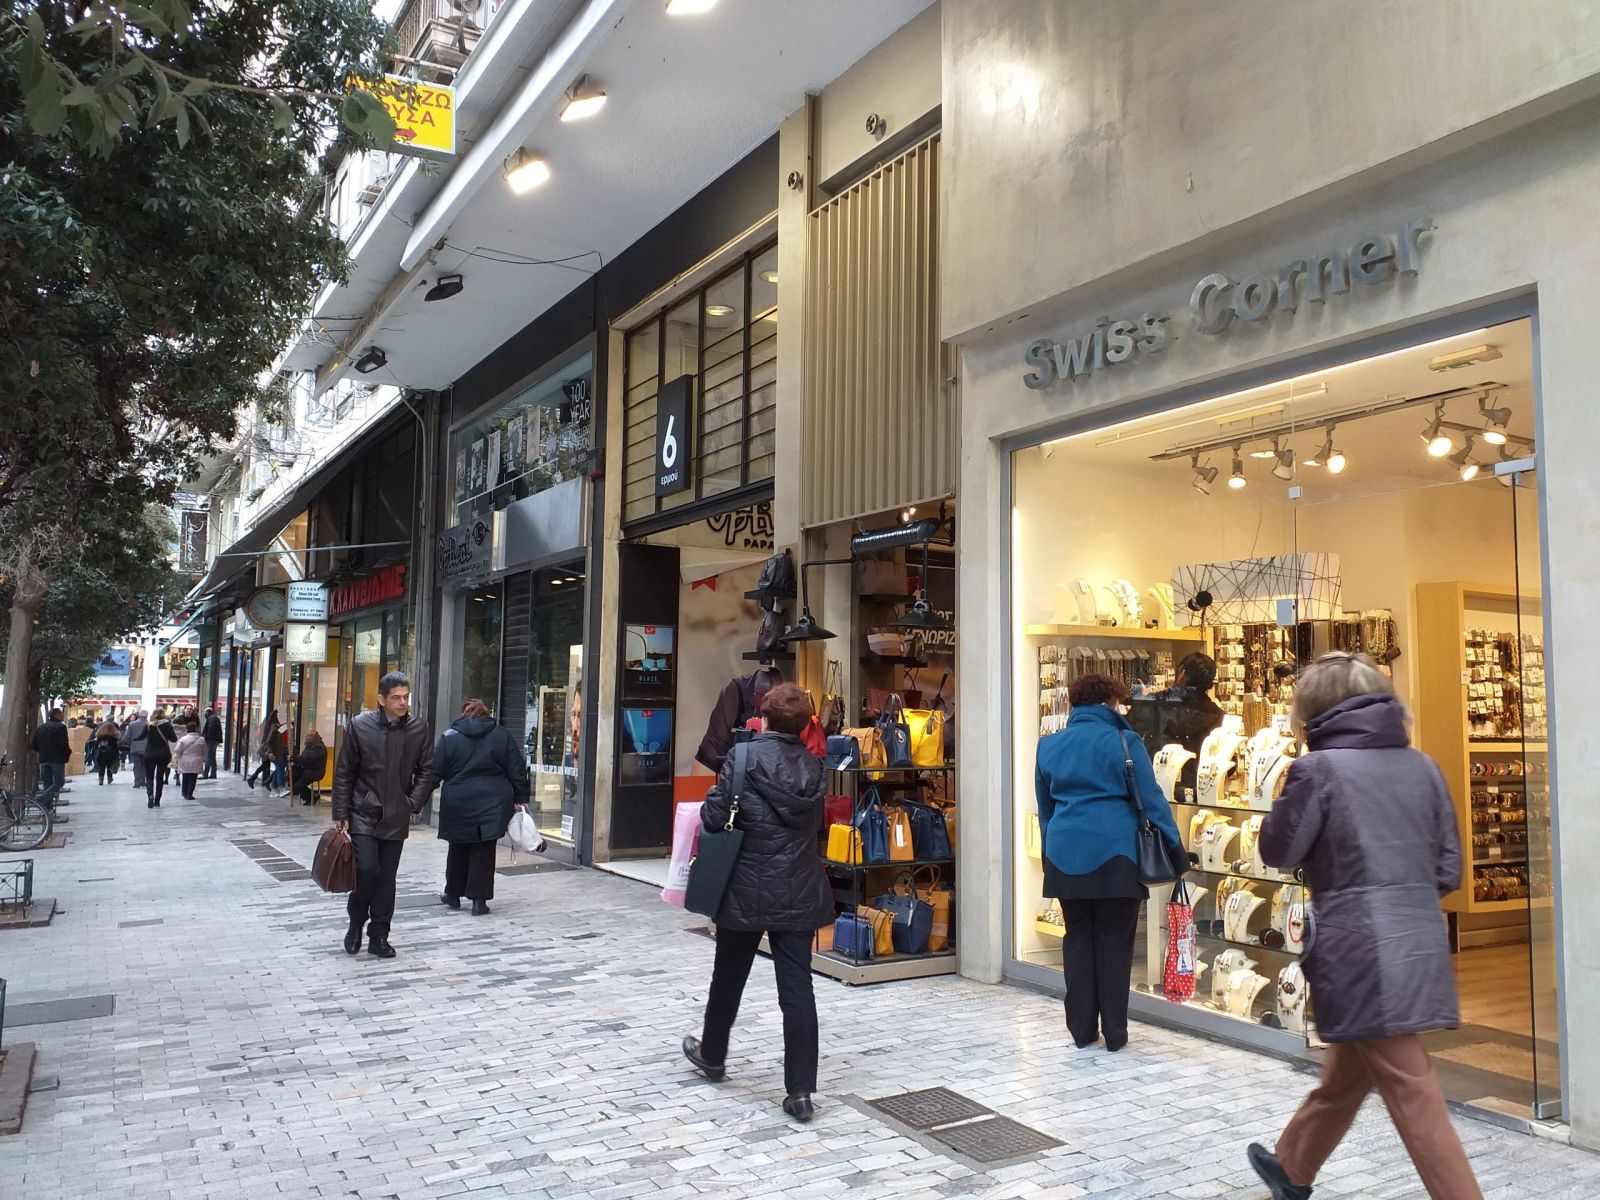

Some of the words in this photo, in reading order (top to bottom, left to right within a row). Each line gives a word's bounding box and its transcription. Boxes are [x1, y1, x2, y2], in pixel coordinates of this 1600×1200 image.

[1022, 311, 1171, 391] Swiss
[1189, 216, 1436, 336] Corner
[662, 414, 677, 469] 6
